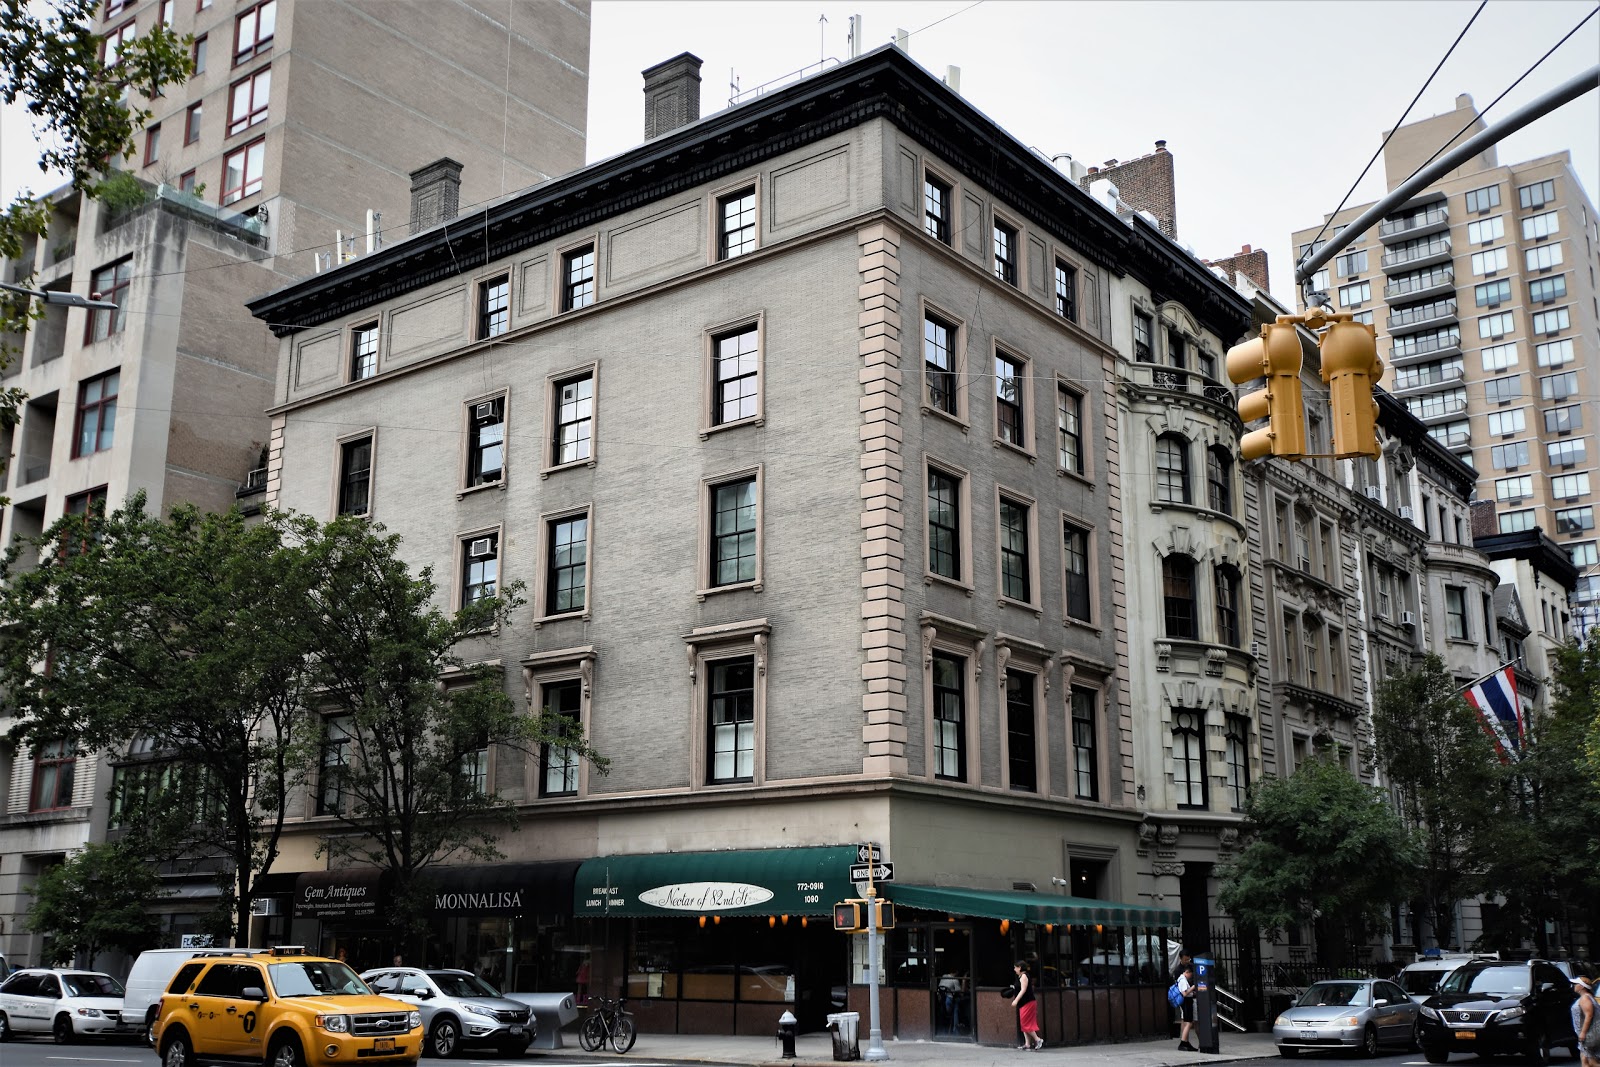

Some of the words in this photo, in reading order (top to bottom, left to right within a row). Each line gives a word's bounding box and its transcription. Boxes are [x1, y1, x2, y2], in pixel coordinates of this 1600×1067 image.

[857, 870, 869, 878] ONE
[874, 869, 887, 877] WAY
[304, 886, 325, 902] Gem
[324, 884, 367, 901] Antiques
[658, 888, 695, 906] Nectar
[697, 887, 710, 909] of
[710, 890, 735, 906] 82nd
[736, 886, 749, 905] St
[804, 895, 819, 903] 1090
[435, 892, 522, 909] MONNALISA
[606, 899, 625, 907] INNER
[1199, 965, 1205, 975] P
[246, 1015, 254, 1031] T
